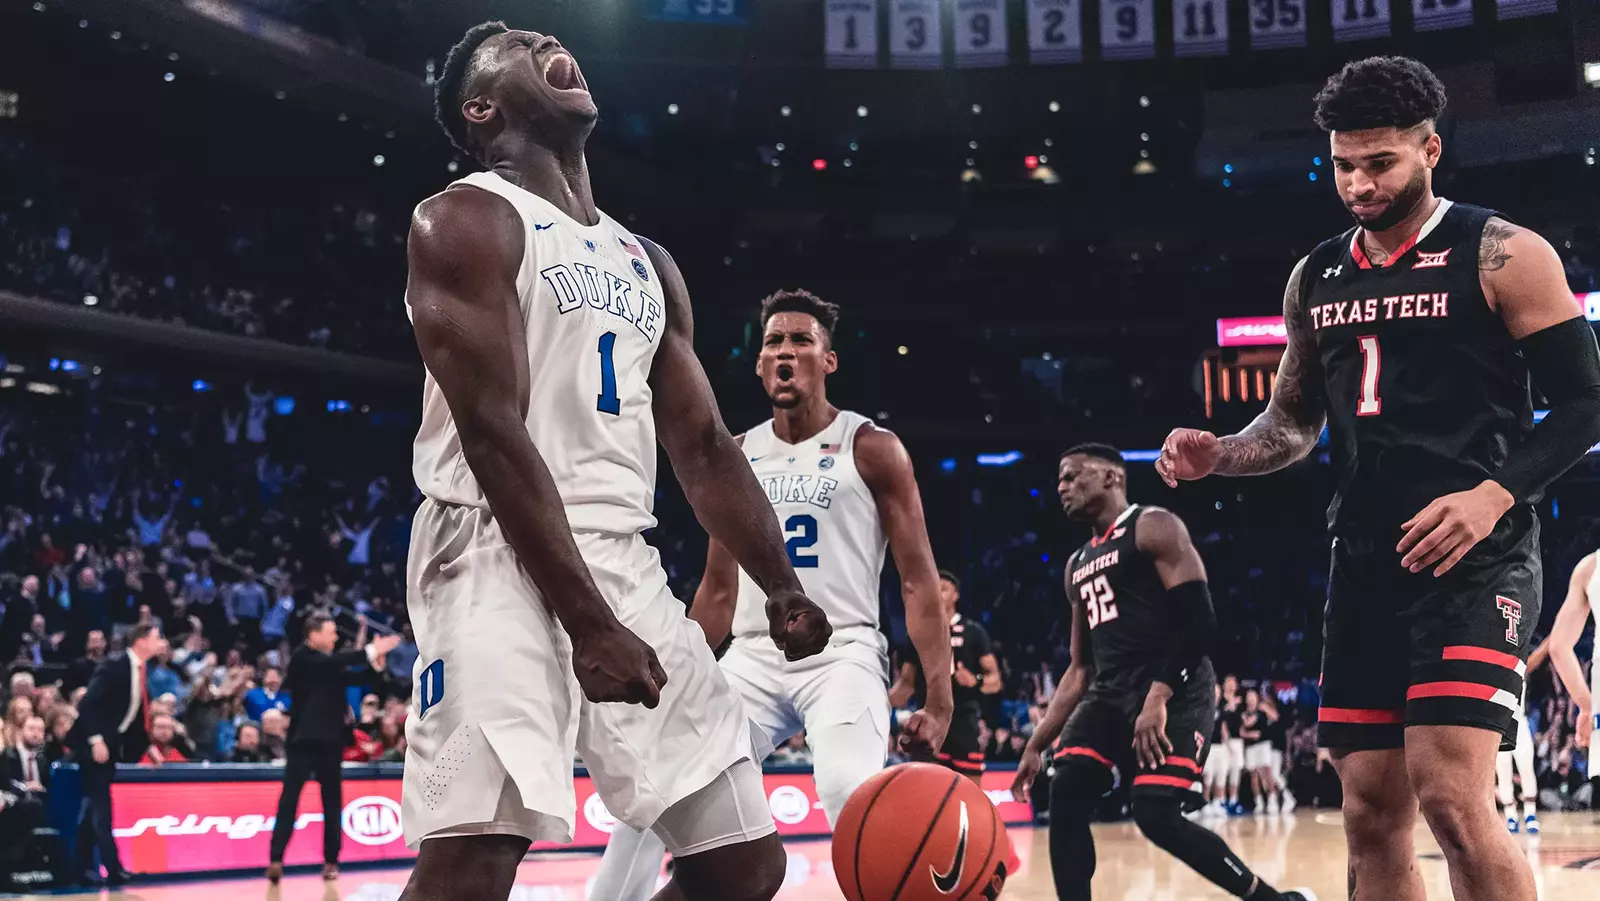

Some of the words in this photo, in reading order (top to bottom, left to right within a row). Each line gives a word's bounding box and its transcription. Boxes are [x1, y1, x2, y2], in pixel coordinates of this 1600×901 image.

[844, 15, 858, 49] 1
[905, 16, 926, 49] 3
[970, 13, 992, 47] 9
[1043, 9, 1067, 43] 2
[1115, 6, 1138, 39] 9
[1184, 2, 1216, 36] 11
[540, 262, 661, 343] DUKE
[1310, 298, 1378, 330] TEXAS
[1383, 292, 1449, 320] TECH
[597, 331, 621, 416] 1
[1356, 335, 1381, 416] 1
[762, 474, 839, 509] UKE
[785, 514, 819, 568] 2
[1072, 559, 1096, 585] TEXAS
[1095, 549, 1119, 572] TECH
[1080, 574, 1119, 630] 32
[419, 658, 445, 720] D
[112, 813, 324, 839] stingr
